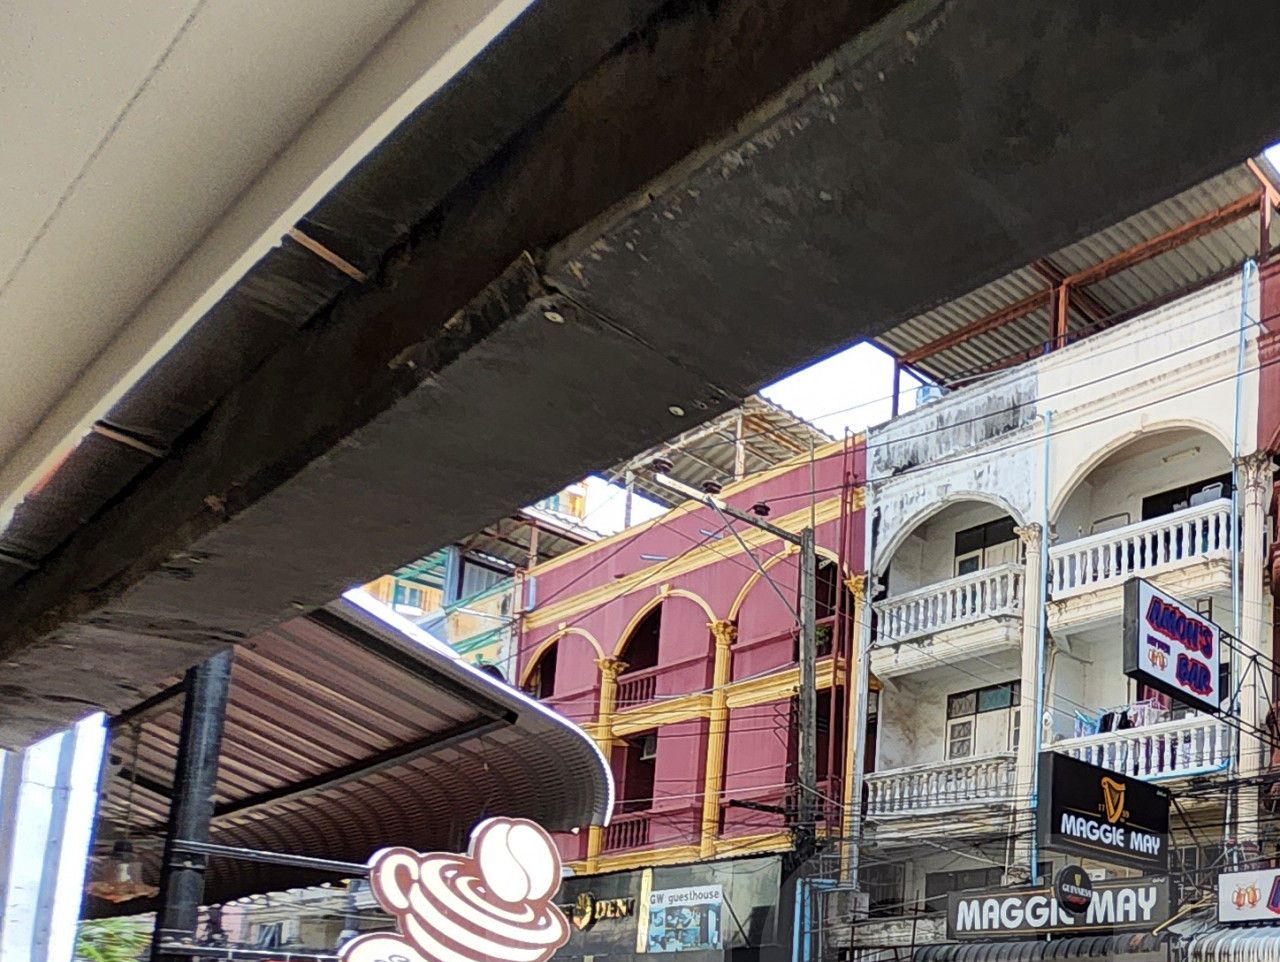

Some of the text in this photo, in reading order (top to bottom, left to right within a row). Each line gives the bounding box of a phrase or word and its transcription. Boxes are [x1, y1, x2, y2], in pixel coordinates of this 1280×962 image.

[1175, 652, 1214, 696] BAR
[1060, 812, 1161, 855] MAGGIE MAY
[650, 889, 721, 905] GW guesthouse
[1086, 887, 1157, 924] MAY
